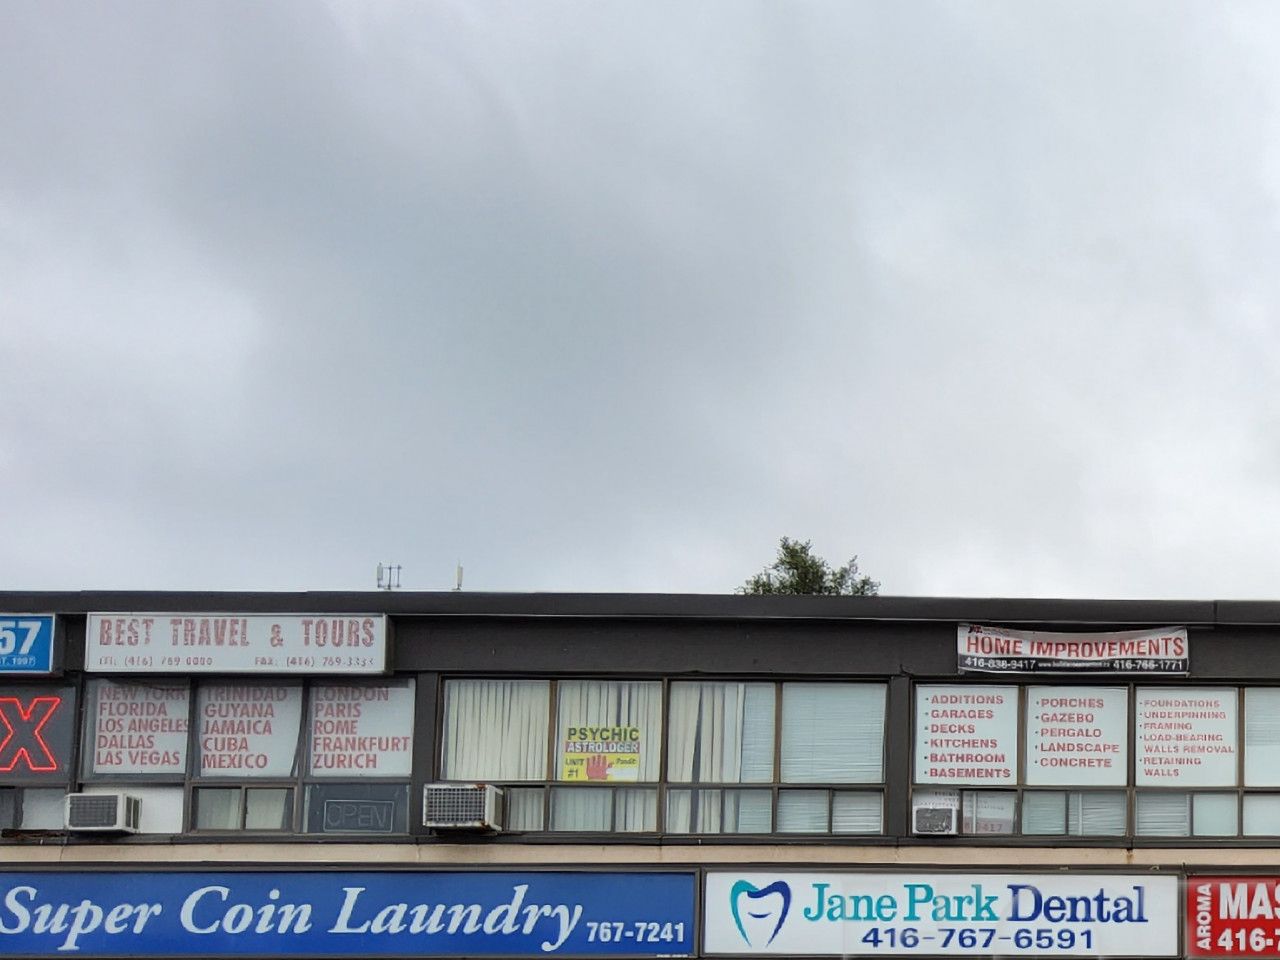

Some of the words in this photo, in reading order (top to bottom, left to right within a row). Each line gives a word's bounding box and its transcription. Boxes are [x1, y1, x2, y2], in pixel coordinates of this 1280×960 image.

[99, 618, 154, 646] BEST
[170, 618, 251, 646] TRAVEL
[270, 623, 284, 648] &
[301, 618, 376, 648] TOURS
[966, 635, 1024, 655] HOME
[1030, 636, 1185, 658] IMPROVEMENTS
[99, 686, 140, 701] NEW
[142, 686, 187, 702] YORK
[202, 686, 288, 702] TRINIDAD
[313, 686, 391, 702] LONDON
[930, 694, 1004, 705] ADDITIONS
[98, 702, 168, 718] FLORIDA
[203, 703, 275, 719] GUYANA
[314, 703, 363, 718] PARIS
[1040, 698, 1105, 709] PORCHES
[1143, 699, 1221, 709] FOUNDATIONS
[930, 709, 994, 720] GARAGES
[1040, 712, 1095, 724] GAZEBO
[1143, 710, 1227, 720] UNDERPINNING
[97, 718, 125, 734] LOS
[127, 718, 190, 734] ANGELES
[202, 719, 274, 736] JAMAICA
[312, 719, 359, 736] ROME
[930, 723, 976, 735] DECKS
[1040, 727, 1103, 739] PERGALO
[1143, 721, 1193, 731] FRAMING
[97, 734, 155, 751] DALLAS
[567, 727, 640, 742] PSYCHIC
[1143, 732, 1224, 743] LOAD-BEARING
[202, 736, 250, 753] CUBA
[313, 736, 411, 753] FRANKFURT
[567, 742, 639, 753] ASTROLOGER
[930, 737, 999, 750] KITCHENS
[1040, 742, 1121, 754] LANDSCAPE
[1144, 744, 1181, 754] WALLS
[1184, 744, 1235, 754] REMOVAL
[95, 750, 125, 766] LAS
[127, 750, 180, 766] VEGAS
[201, 753, 268, 770] MEXICO
[312, 753, 379, 770] ZURICH
[930, 753, 1006, 765] BATHROOM
[1040, 757, 1114, 769] CONCRETE
[1143, 756, 1202, 766] RETAINING
[930, 767, 1011, 779] BASEMENTS
[1144, 768, 1180, 778] WALLS
[325, 804, 388, 828] OPEN
[801, 883, 898, 922] Jane
[902, 883, 1000, 922] Park
[1006, 883, 1150, 922] Dental
[0, 884, 162, 952] Super
[180, 884, 313, 935] Coin
[328, 884, 586, 952] Laundry
[1196, 883, 1215, 952] AROMA
[586, 921, 687, 944] 767-7241
[860, 928, 1094, 949] 416-767-6591
